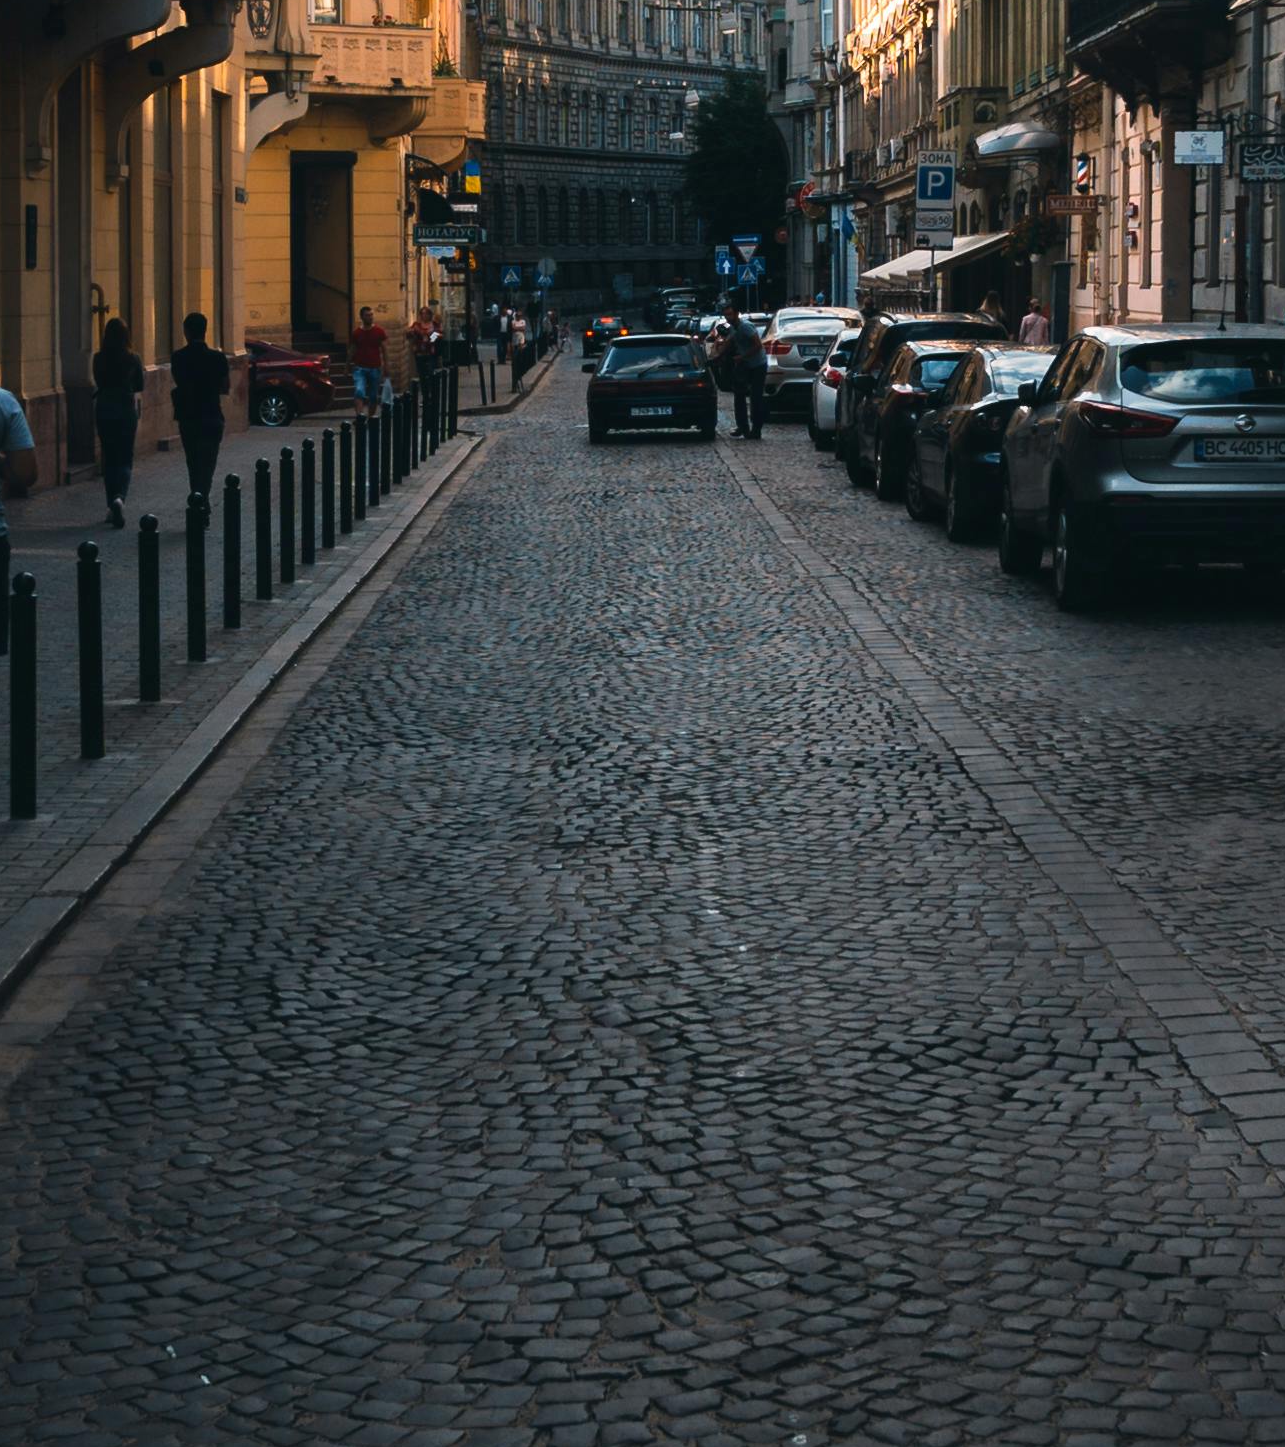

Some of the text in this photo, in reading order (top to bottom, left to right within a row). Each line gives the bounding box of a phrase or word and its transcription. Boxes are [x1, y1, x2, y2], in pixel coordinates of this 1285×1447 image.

[920, 153, 952, 164] ЗОНА
[927, 170, 946, 197] P
[417, 227, 475, 238] НОТАРІУС
[1205, 440, 1227, 455] BC
[1230, 440, 1264, 455] 4405
